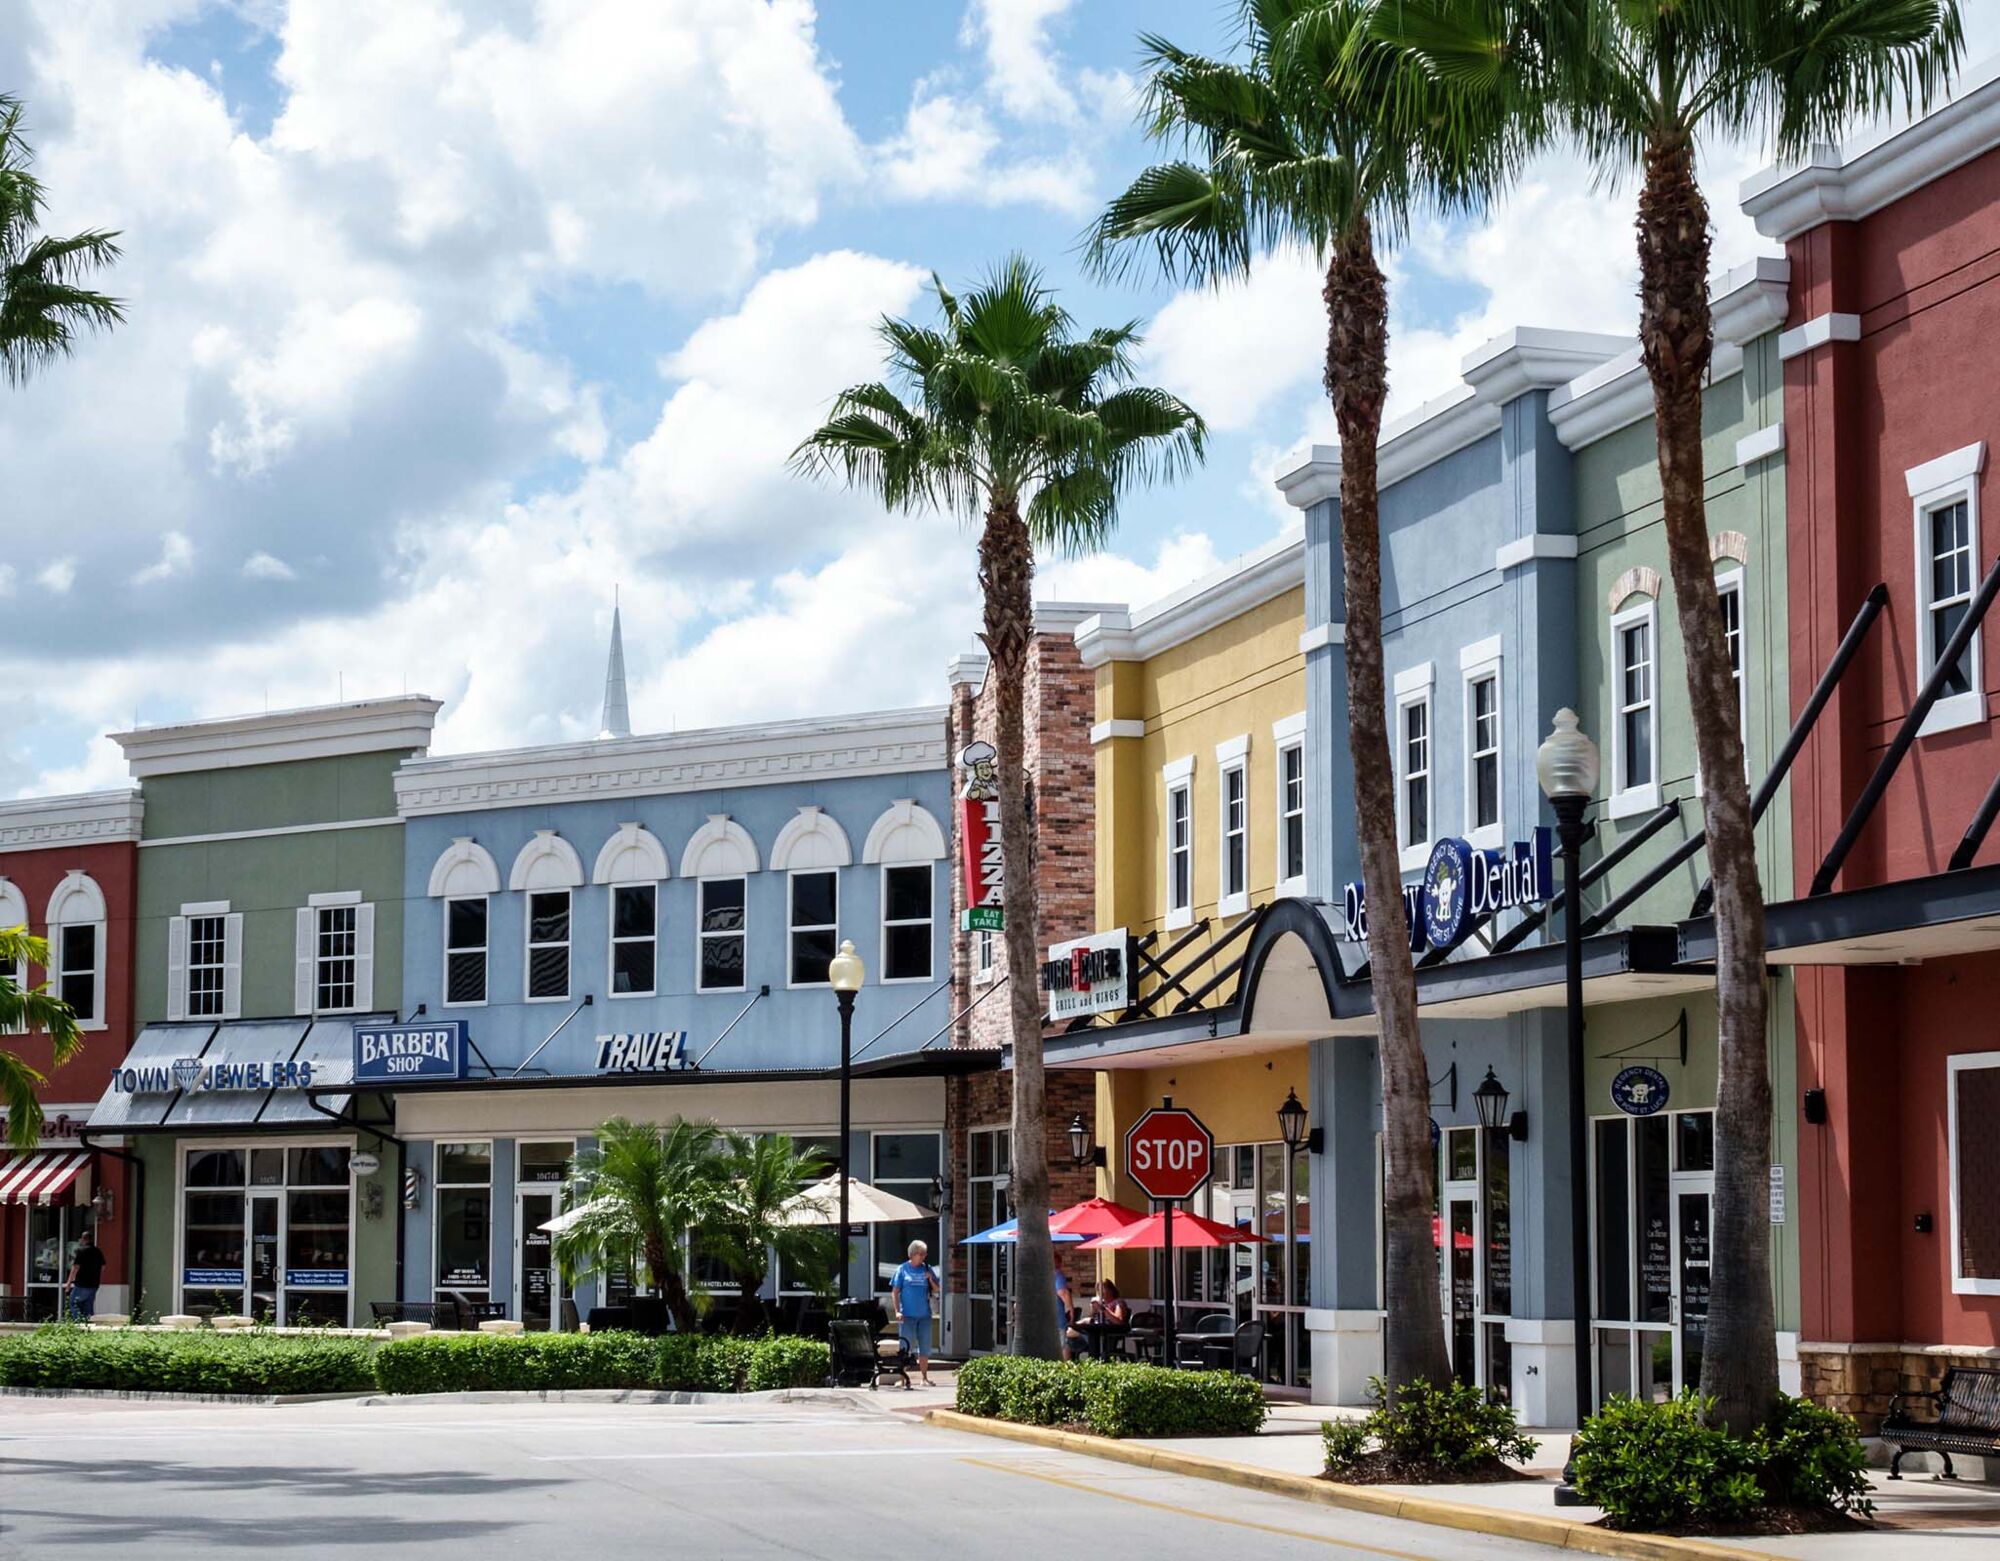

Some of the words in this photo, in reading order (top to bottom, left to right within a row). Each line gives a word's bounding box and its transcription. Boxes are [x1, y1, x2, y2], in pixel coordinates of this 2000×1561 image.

[1470, 826, 1540, 914] Dental
[973, 919, 998, 928] TAKE
[983, 909, 999, 918] EAT
[1055, 997, 1076, 1012] GRILL
[1095, 989, 1120, 1005] WINGS
[361, 1031, 450, 1065] BARBER
[594, 1031, 683, 1069] TRAVEL
[111, 1066, 170, 1094] TOWN
[202, 1061, 312, 1091] JEWELERS
[386, 1056, 424, 1073] SHOP
[1135, 1138, 1203, 1170] STOP
